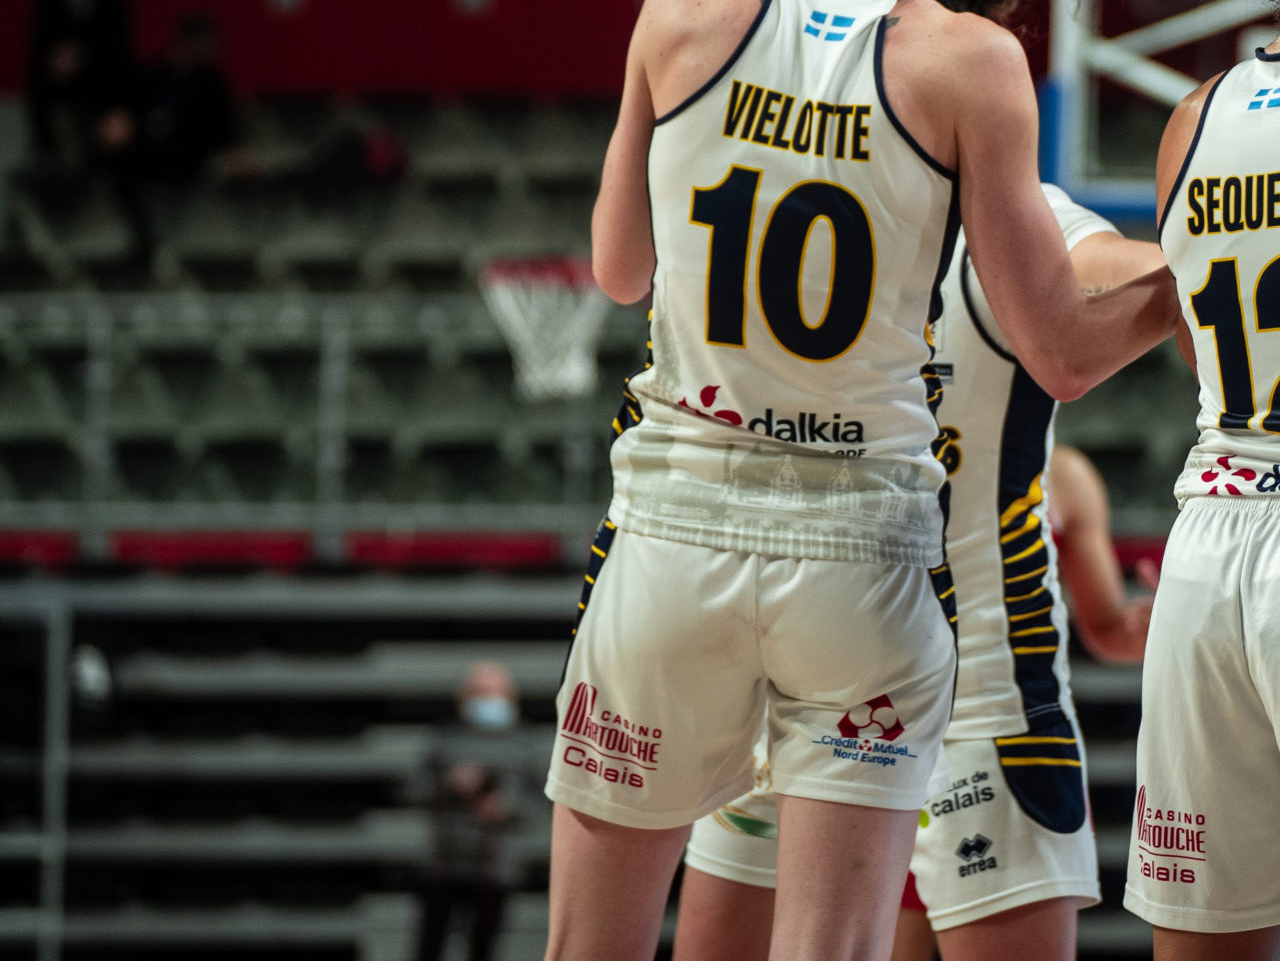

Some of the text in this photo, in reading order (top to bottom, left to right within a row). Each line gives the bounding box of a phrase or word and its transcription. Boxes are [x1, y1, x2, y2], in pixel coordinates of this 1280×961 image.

[722, 79, 871, 162] VIELOTTE
[689, 163, 877, 363] 10
[748, 408, 864, 443] dalkia
[601, 710, 662, 739] CASINO
[563, 745, 644, 788] Calais
[833, 748, 897, 766] Nord Europe
[931, 785, 995, 817] calais
[1146, 807, 1206, 826] CASINO
